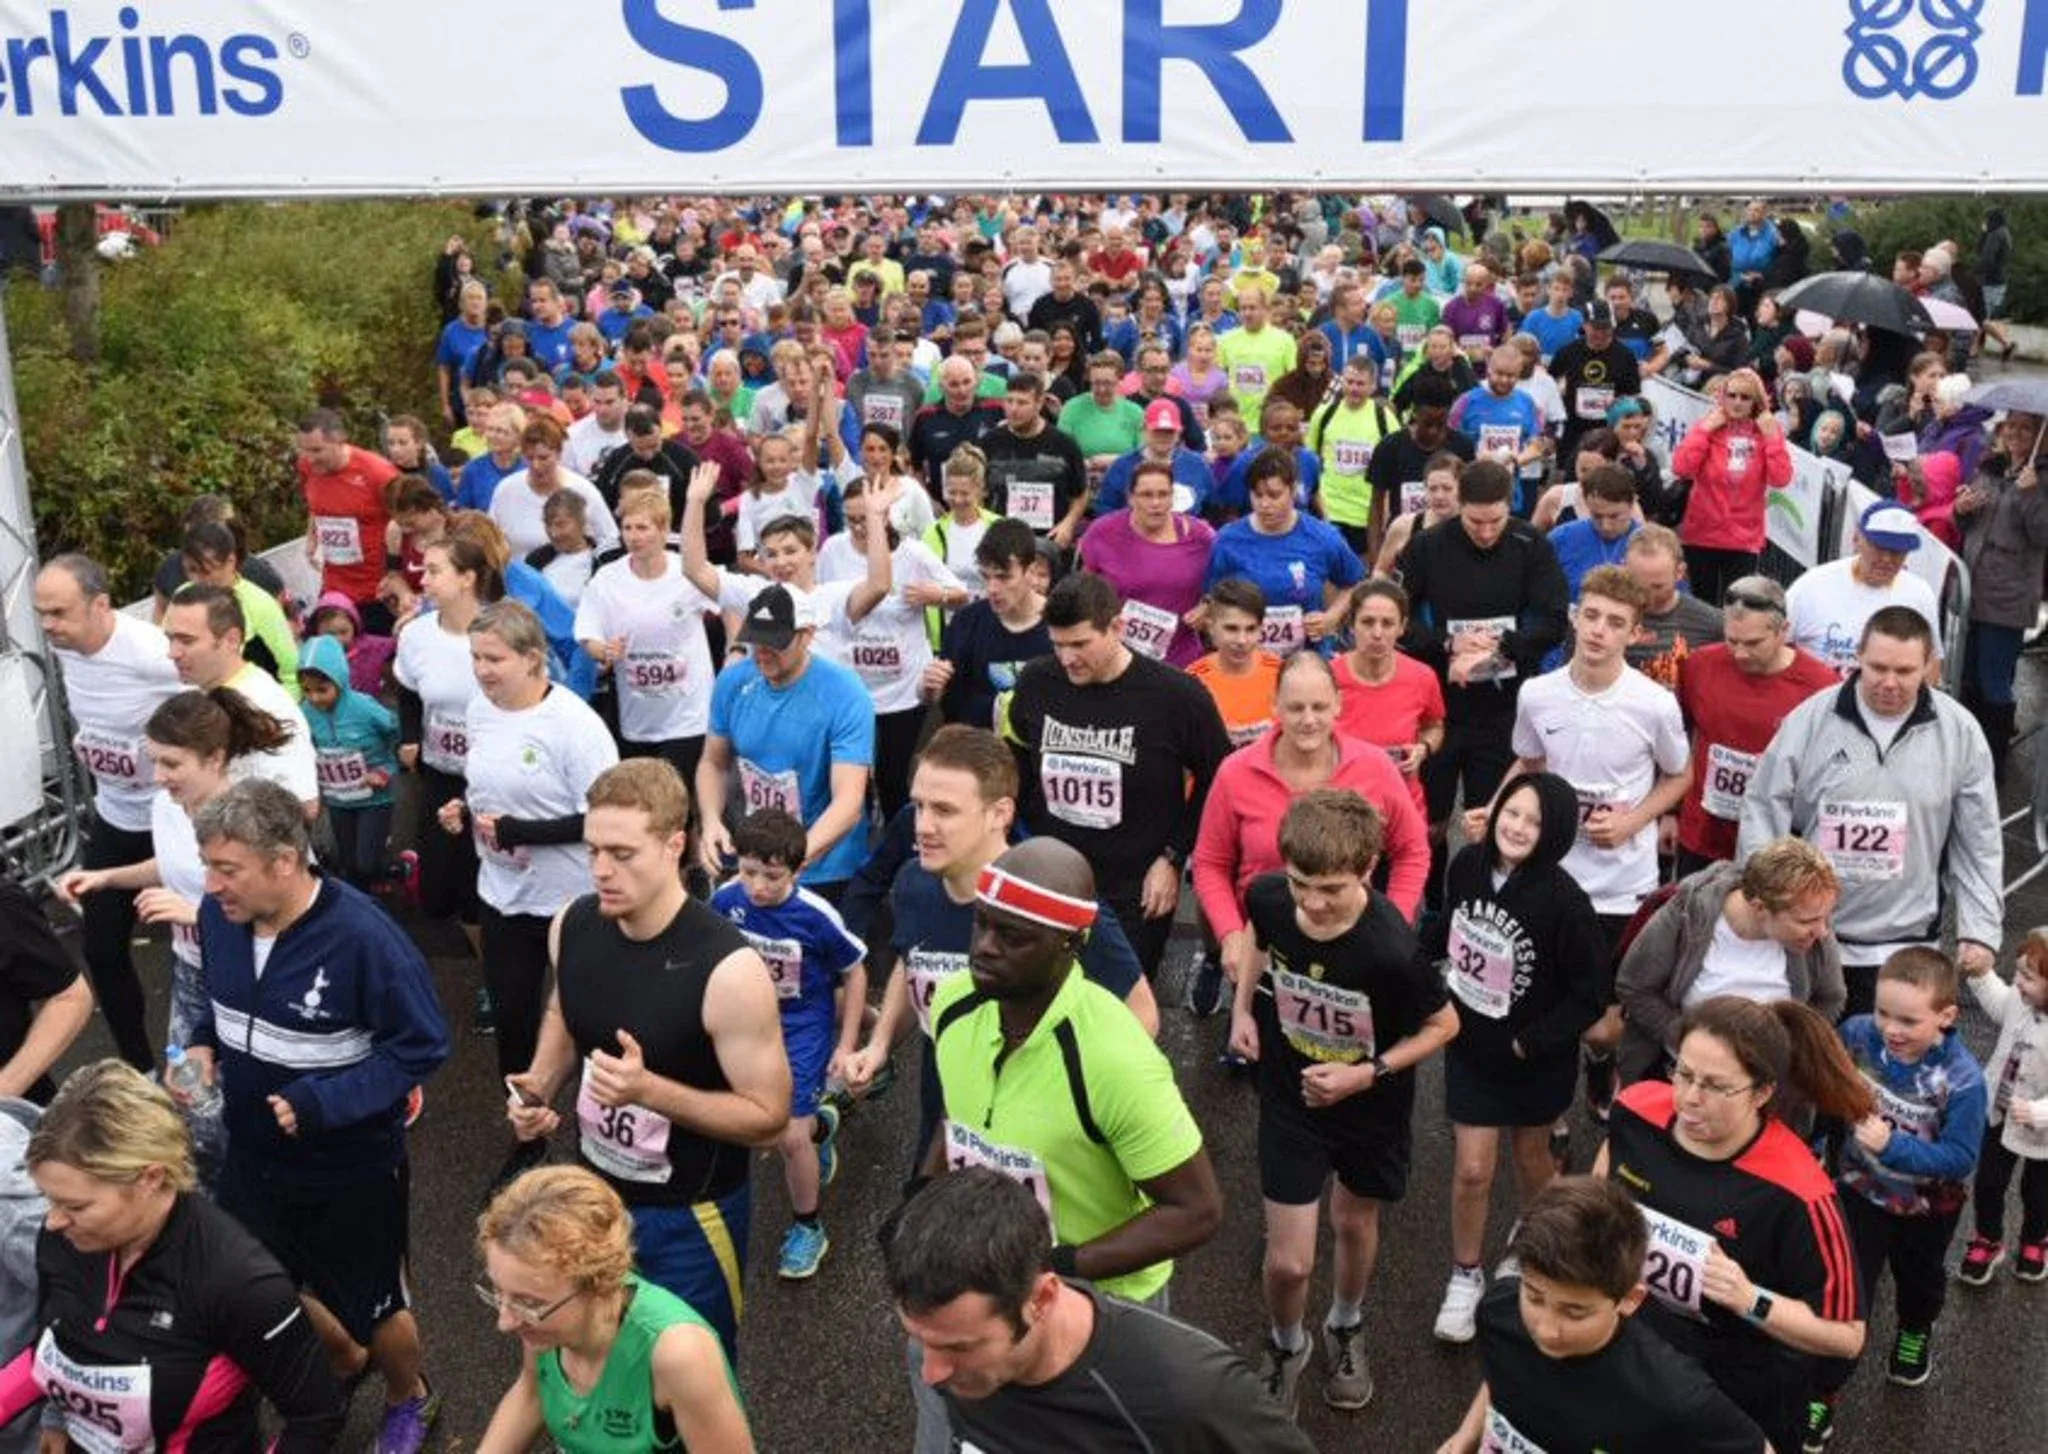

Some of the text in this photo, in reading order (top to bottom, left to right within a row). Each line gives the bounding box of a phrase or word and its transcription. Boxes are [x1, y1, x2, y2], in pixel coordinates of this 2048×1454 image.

[620, 0, 1406, 153] START
[1019, 495, 1041, 512] 37
[322, 530, 351, 548] 823
[1126, 617, 1165, 643] 557
[853, 646, 900, 667] 1029
[636, 664, 675, 687] 594
[1040, 714, 1136, 766] LONSDALE
[80, 745, 135, 778] 1250
[1047, 776, 1115, 808] 1015
[1714, 767, 1747, 797] 68
[1832, 822, 1889, 852] 122
[1473, 899, 1535, 962] ANGELES
[914, 955, 969, 973] Perkin
[1458, 944, 1487, 984] 32
[1291, 995, 1356, 1037] 715
[597, 1103, 636, 1148] 36
[1650, 1222, 1697, 1255] rkins
[1647, 1250, 1694, 1302] 20
